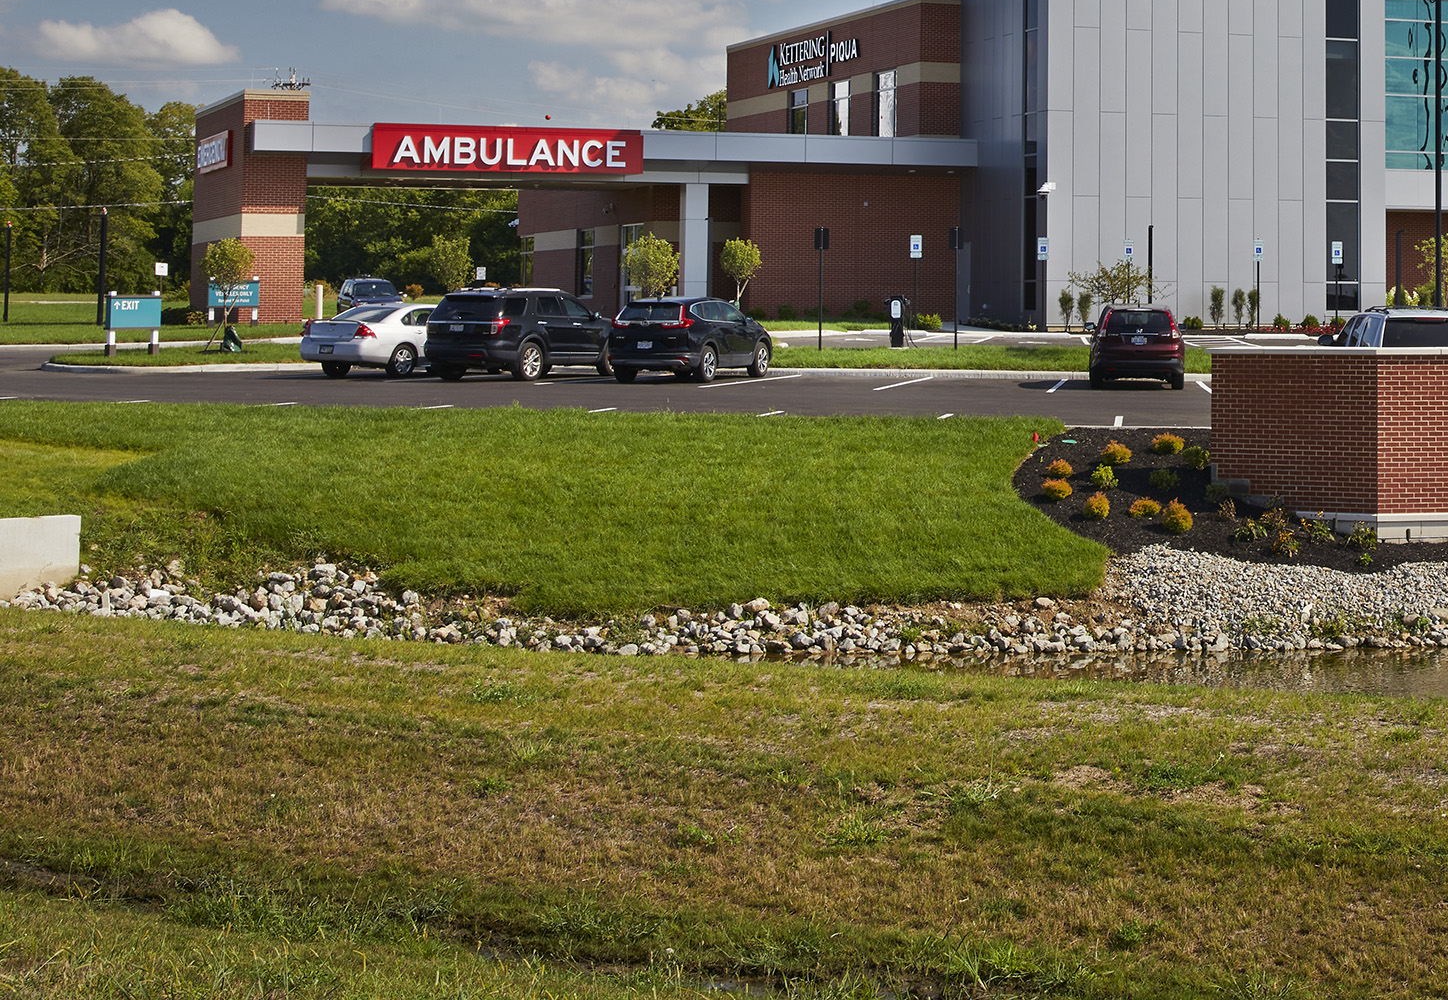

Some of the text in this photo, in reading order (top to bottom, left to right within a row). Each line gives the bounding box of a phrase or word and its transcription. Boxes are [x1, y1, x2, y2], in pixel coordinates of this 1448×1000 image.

[779, 36, 825, 67] KETTERING
[829, 38, 858, 63] PIQUA
[778, 61, 825, 87] Health Network
[393, 135, 626, 167] AMBULANCE
[121, 300, 140, 310] EXIT
